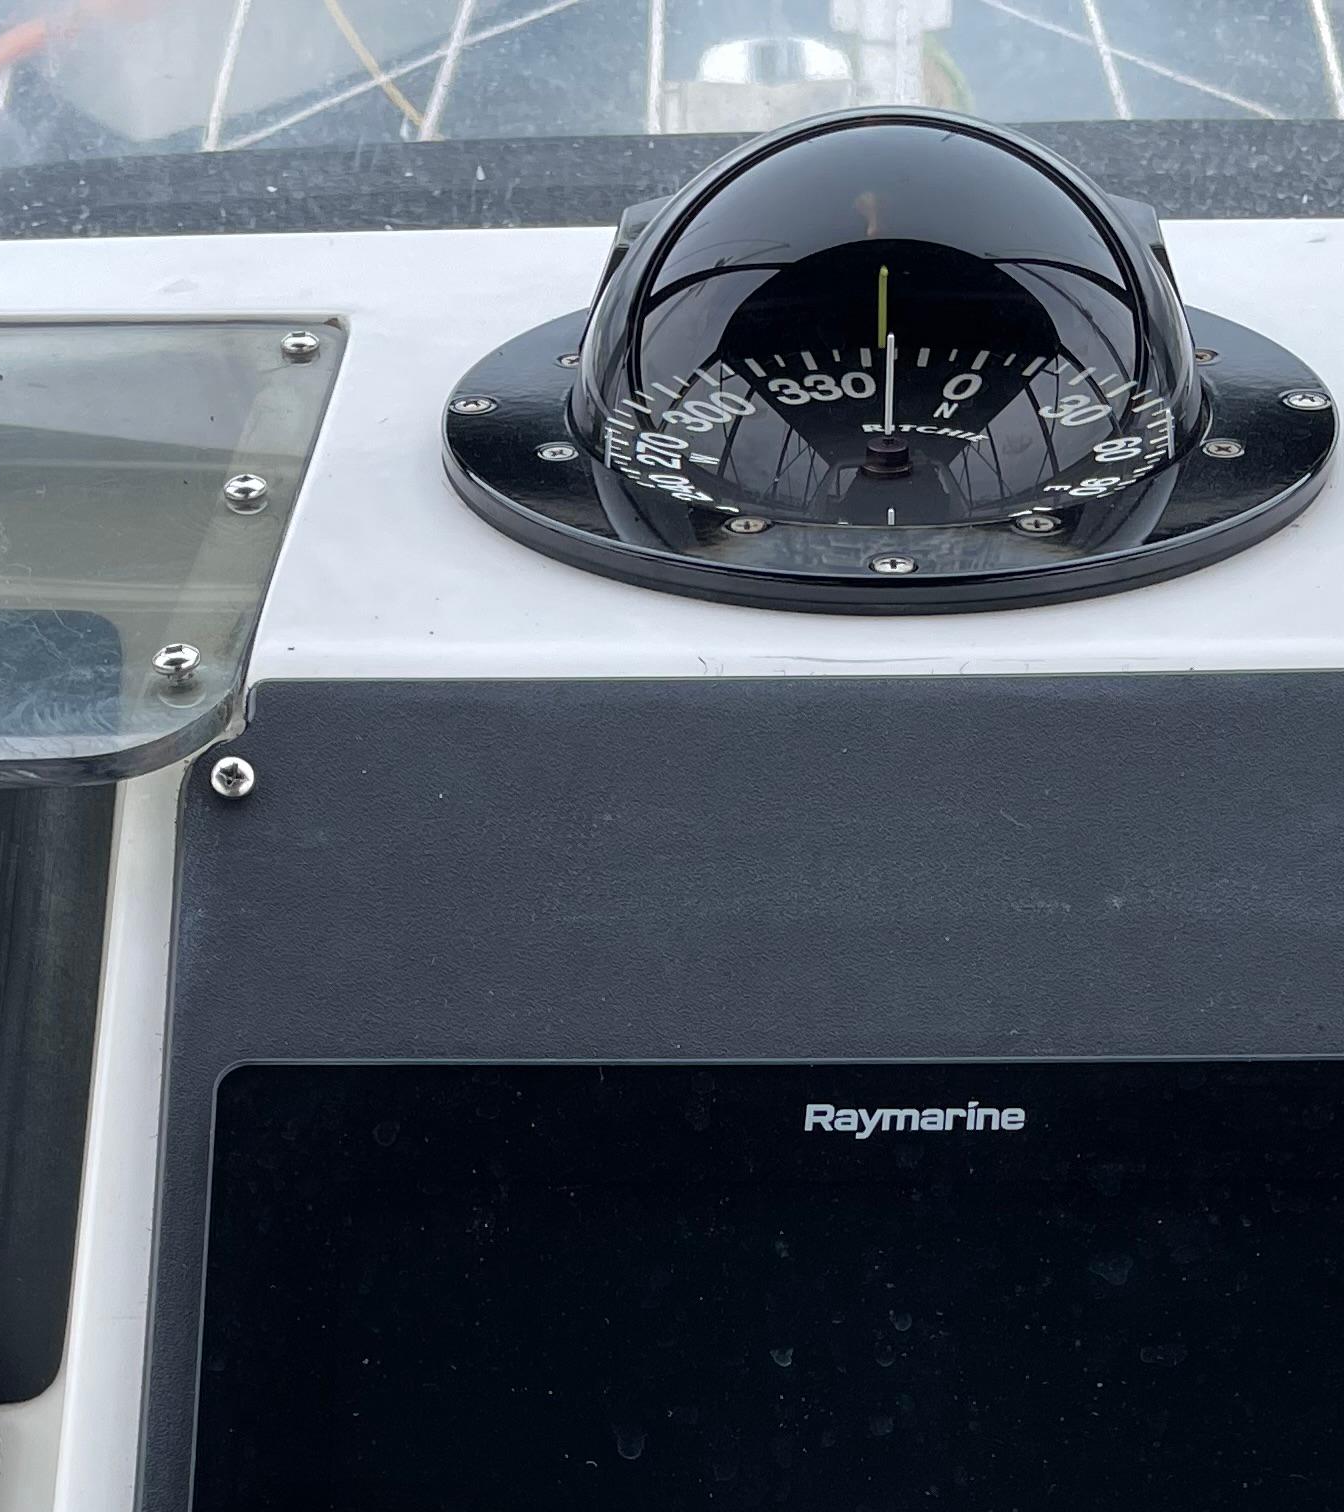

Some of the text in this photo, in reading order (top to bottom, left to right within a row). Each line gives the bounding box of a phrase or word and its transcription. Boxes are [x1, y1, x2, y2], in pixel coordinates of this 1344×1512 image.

[767, 371, 876, 405] 330
[943, 373, 982, 400] 0
[662, 391, 756, 432] 300
[933, 401, 958, 419] N
[1038, 394, 1112, 426] 30
[636, 432, 689, 470] 270
[1093, 437, 1142, 462] 60
[1069, 477, 1121, 496] 90
[804, 1101, 1026, 1140] Raymarine
